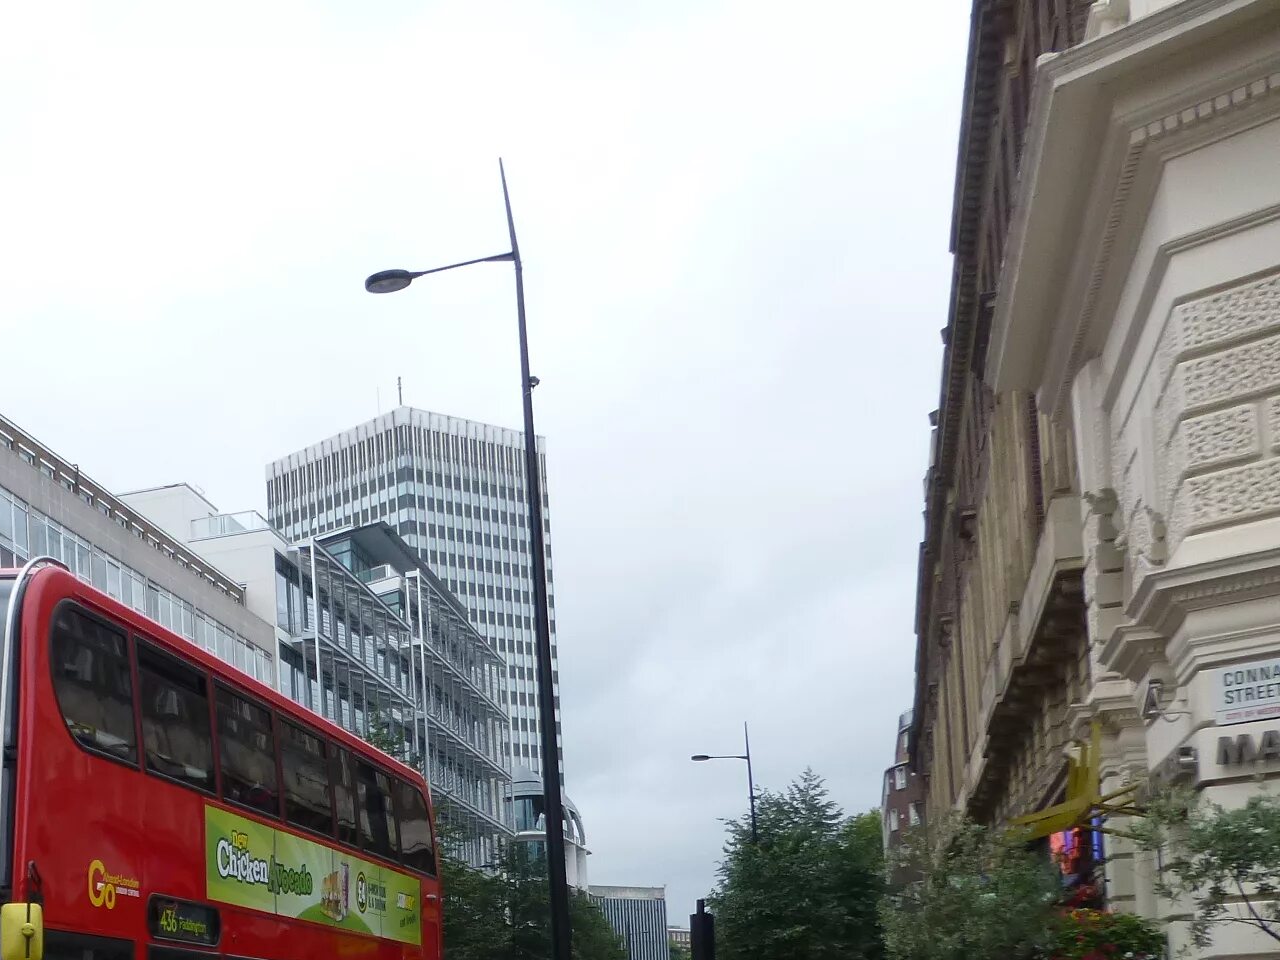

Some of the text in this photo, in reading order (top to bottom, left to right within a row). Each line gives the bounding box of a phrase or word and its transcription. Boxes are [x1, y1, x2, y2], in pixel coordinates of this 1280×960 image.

[88, 859, 116, 910] Go
[216, 837, 269, 885] Chicken
[267, 855, 313, 896] Avocado
[160, 908, 177, 933] 436
